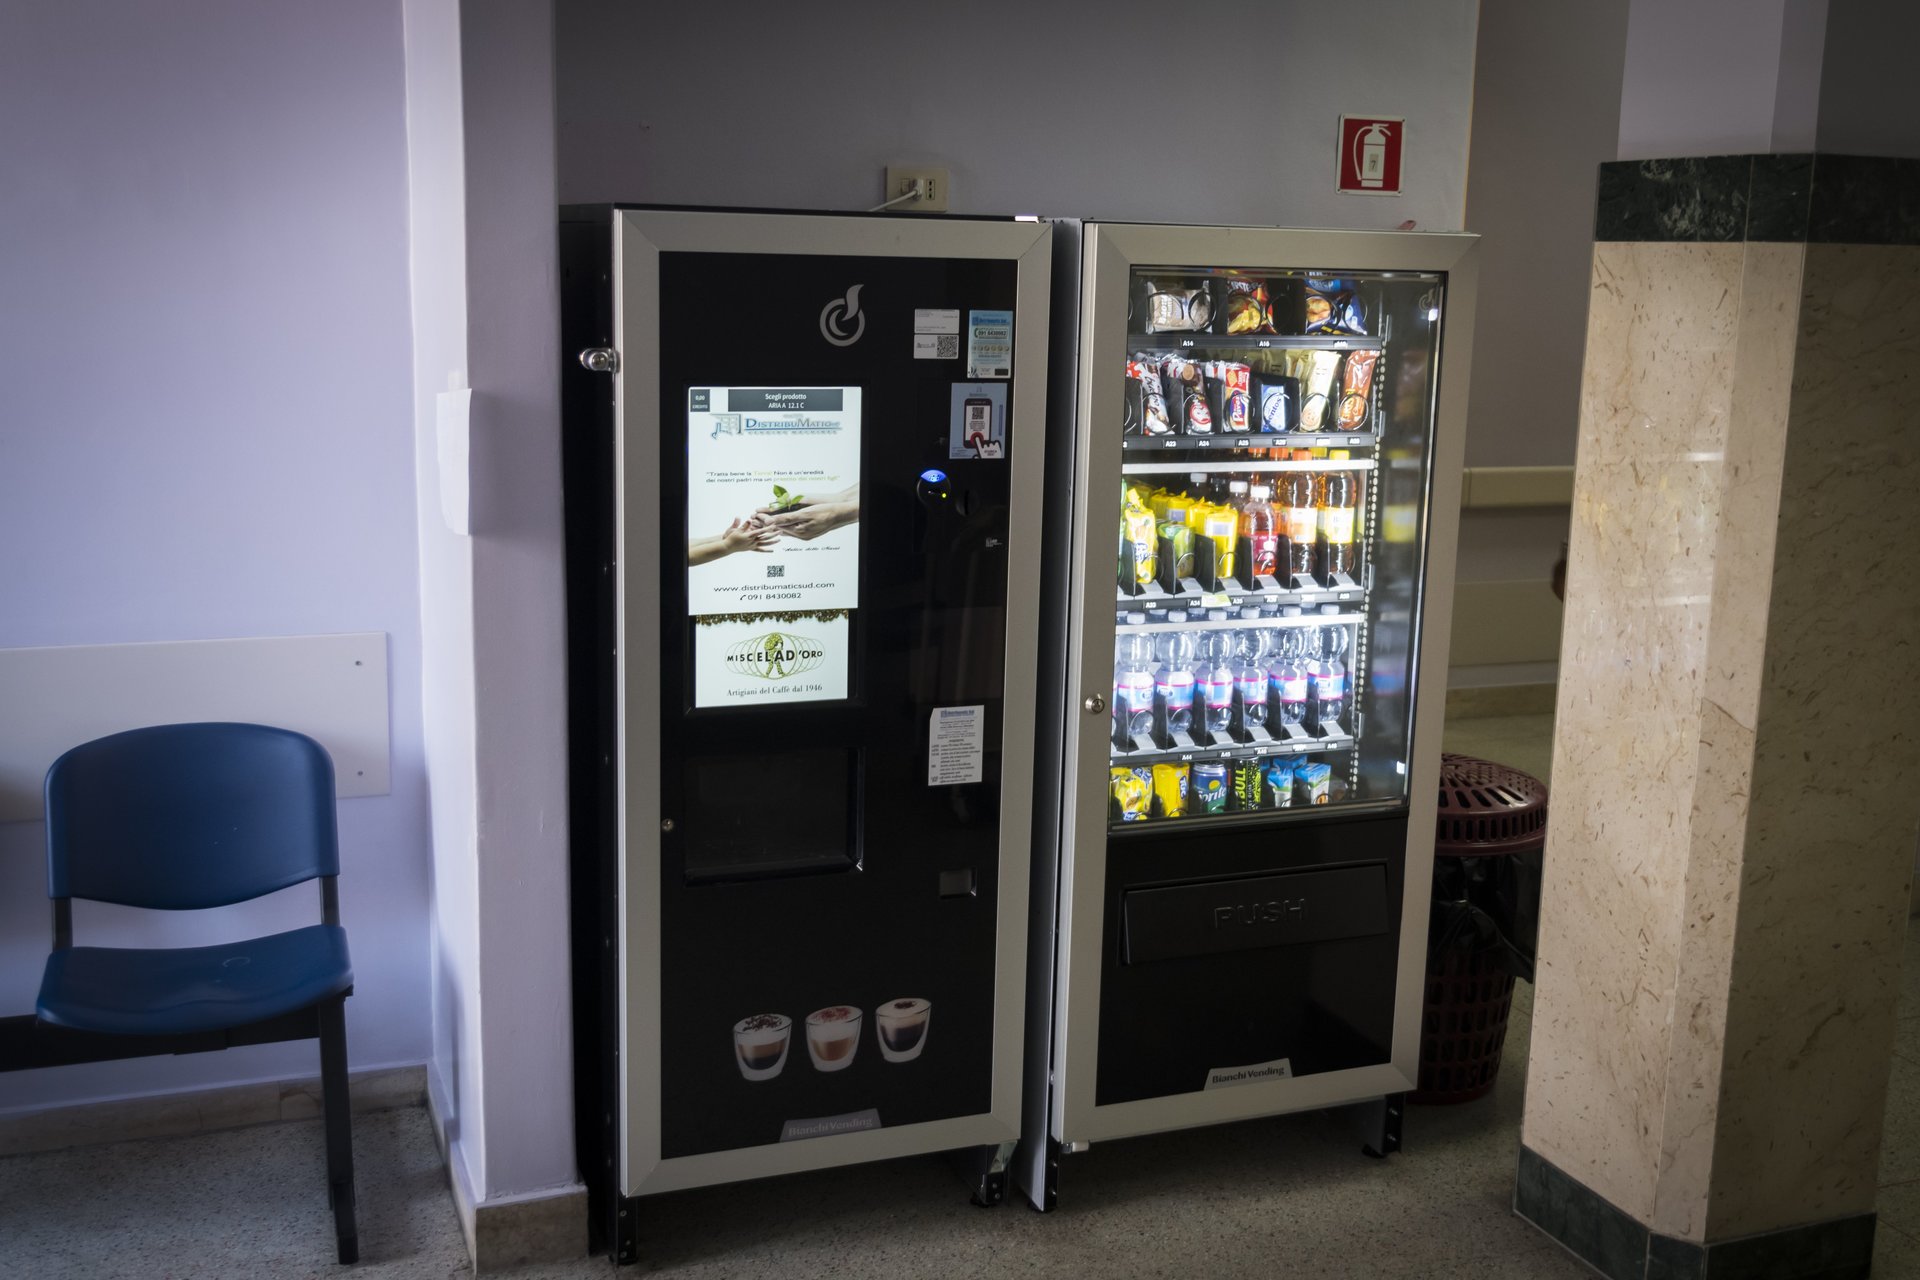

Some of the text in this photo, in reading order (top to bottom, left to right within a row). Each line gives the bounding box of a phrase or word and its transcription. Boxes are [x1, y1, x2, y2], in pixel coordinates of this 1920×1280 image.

[714, 582, 835, 592] www.distribumaticsud.com
[727, 688, 758, 696] Artigiani
[805, 684, 823, 692] 1946
[1214, 898, 1306, 928] PUSH
[1212, 1067, 1284, 1084] Bianchi Vending
[788, 1118, 873, 1136] Bianchi Vending
